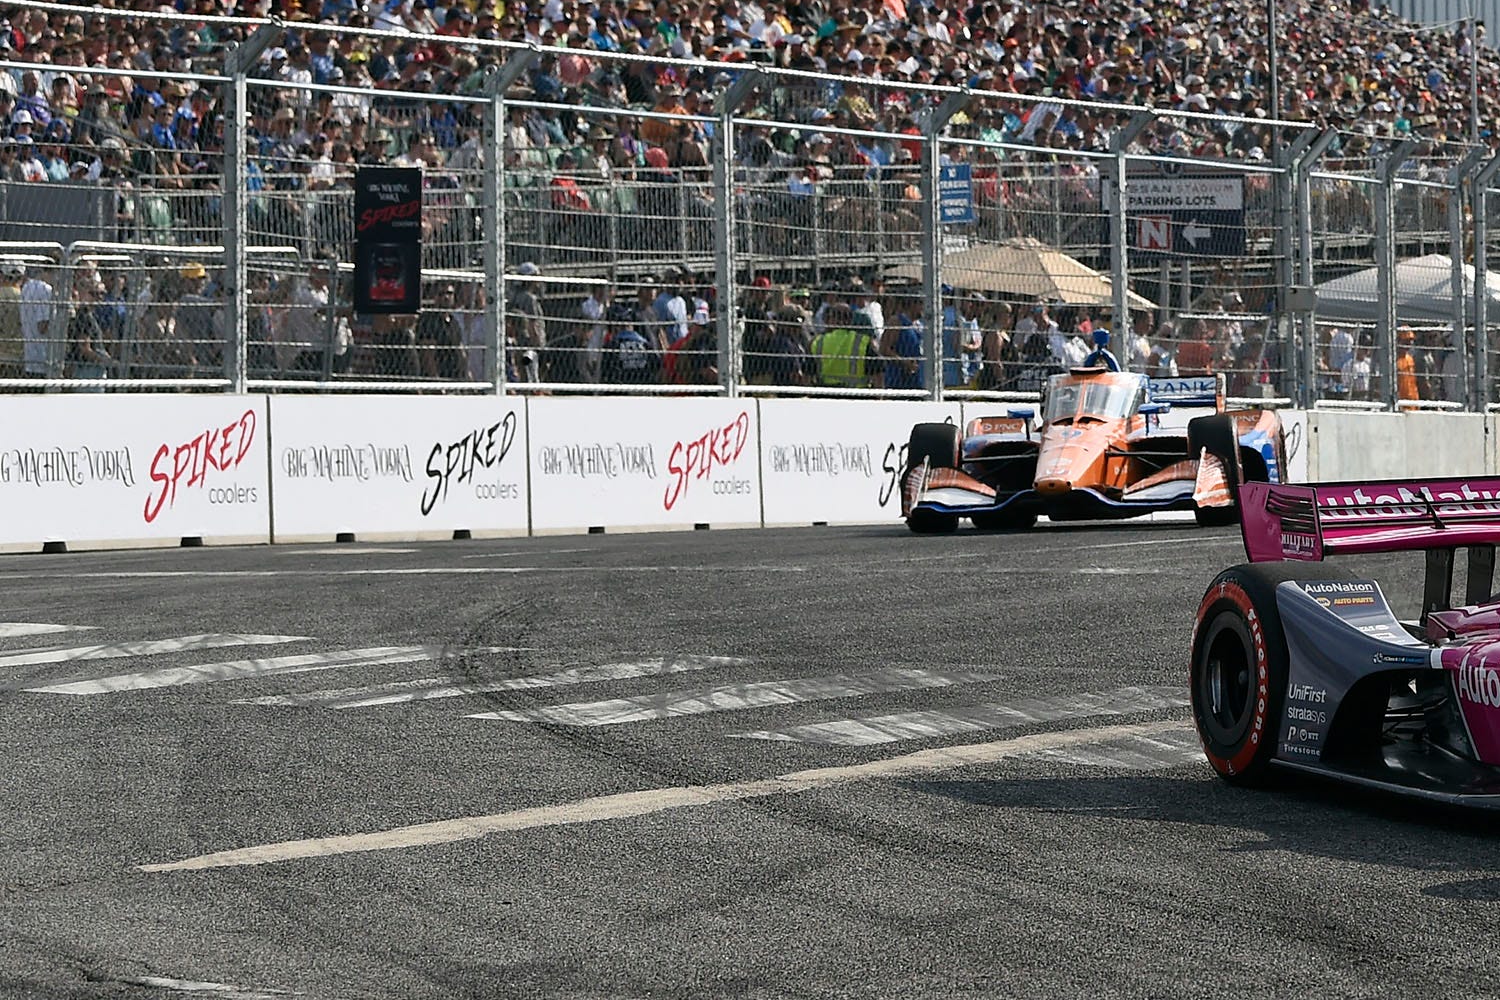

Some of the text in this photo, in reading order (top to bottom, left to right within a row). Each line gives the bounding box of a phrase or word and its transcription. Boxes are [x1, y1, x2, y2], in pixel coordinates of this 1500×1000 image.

[1129, 196, 1217, 206] PARKING LOTS
[12, 447, 84, 488] MACHINE
[81, 445, 136, 487] VODKA
[144, 409, 257, 523] SPIKED
[309, 444, 369, 482] MACHINE
[368, 443, 414, 483] VODKA
[421, 410, 517, 516] SPIKED
[664, 411, 749, 511] SPIKED
[209, 483, 258, 504] coolers
[475, 479, 519, 500] coolers
[712, 476, 751, 496] coolers
[1305, 582, 1374, 594] AutoNation
[1247, 608, 1268, 745] Firestone
[1288, 683, 1327, 703] UniFirst
[1287, 706, 1326, 724] stratasys
[1283, 743, 1321, 756] Firestone
